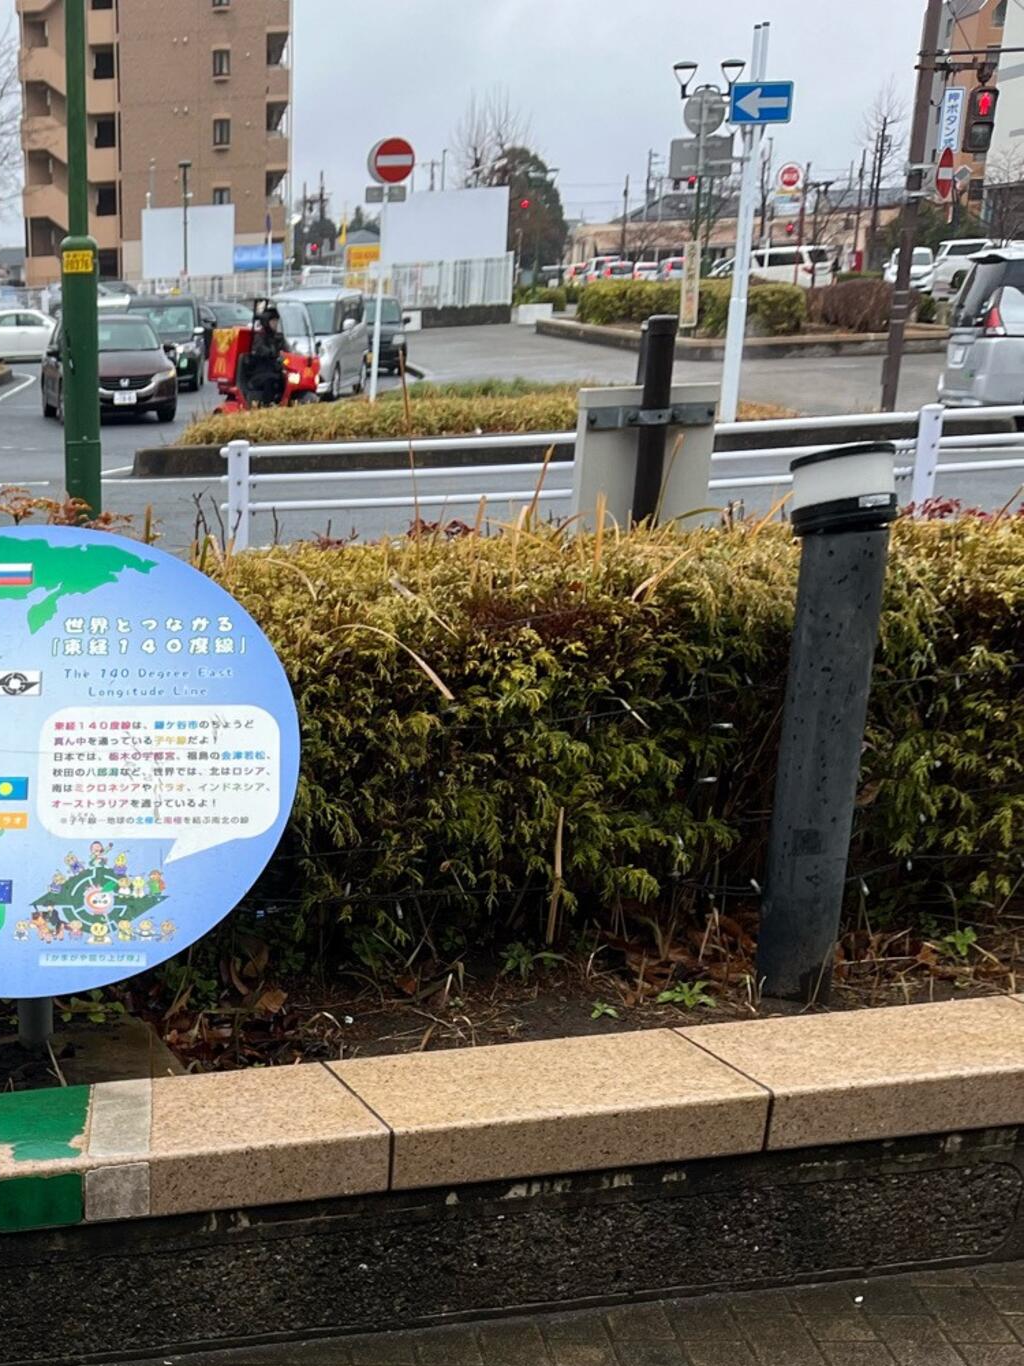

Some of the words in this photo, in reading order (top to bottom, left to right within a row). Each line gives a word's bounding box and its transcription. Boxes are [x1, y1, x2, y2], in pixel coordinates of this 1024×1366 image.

[64, 616, 234, 634] 世界とつながる
[64, 668, 91, 678] The
[100, 668, 130, 679] 140
[138, 668, 190, 680] Degree
[198, 667, 234, 678] East
[88, 686, 166, 698] Longitude
[174, 686, 208, 696] Line
